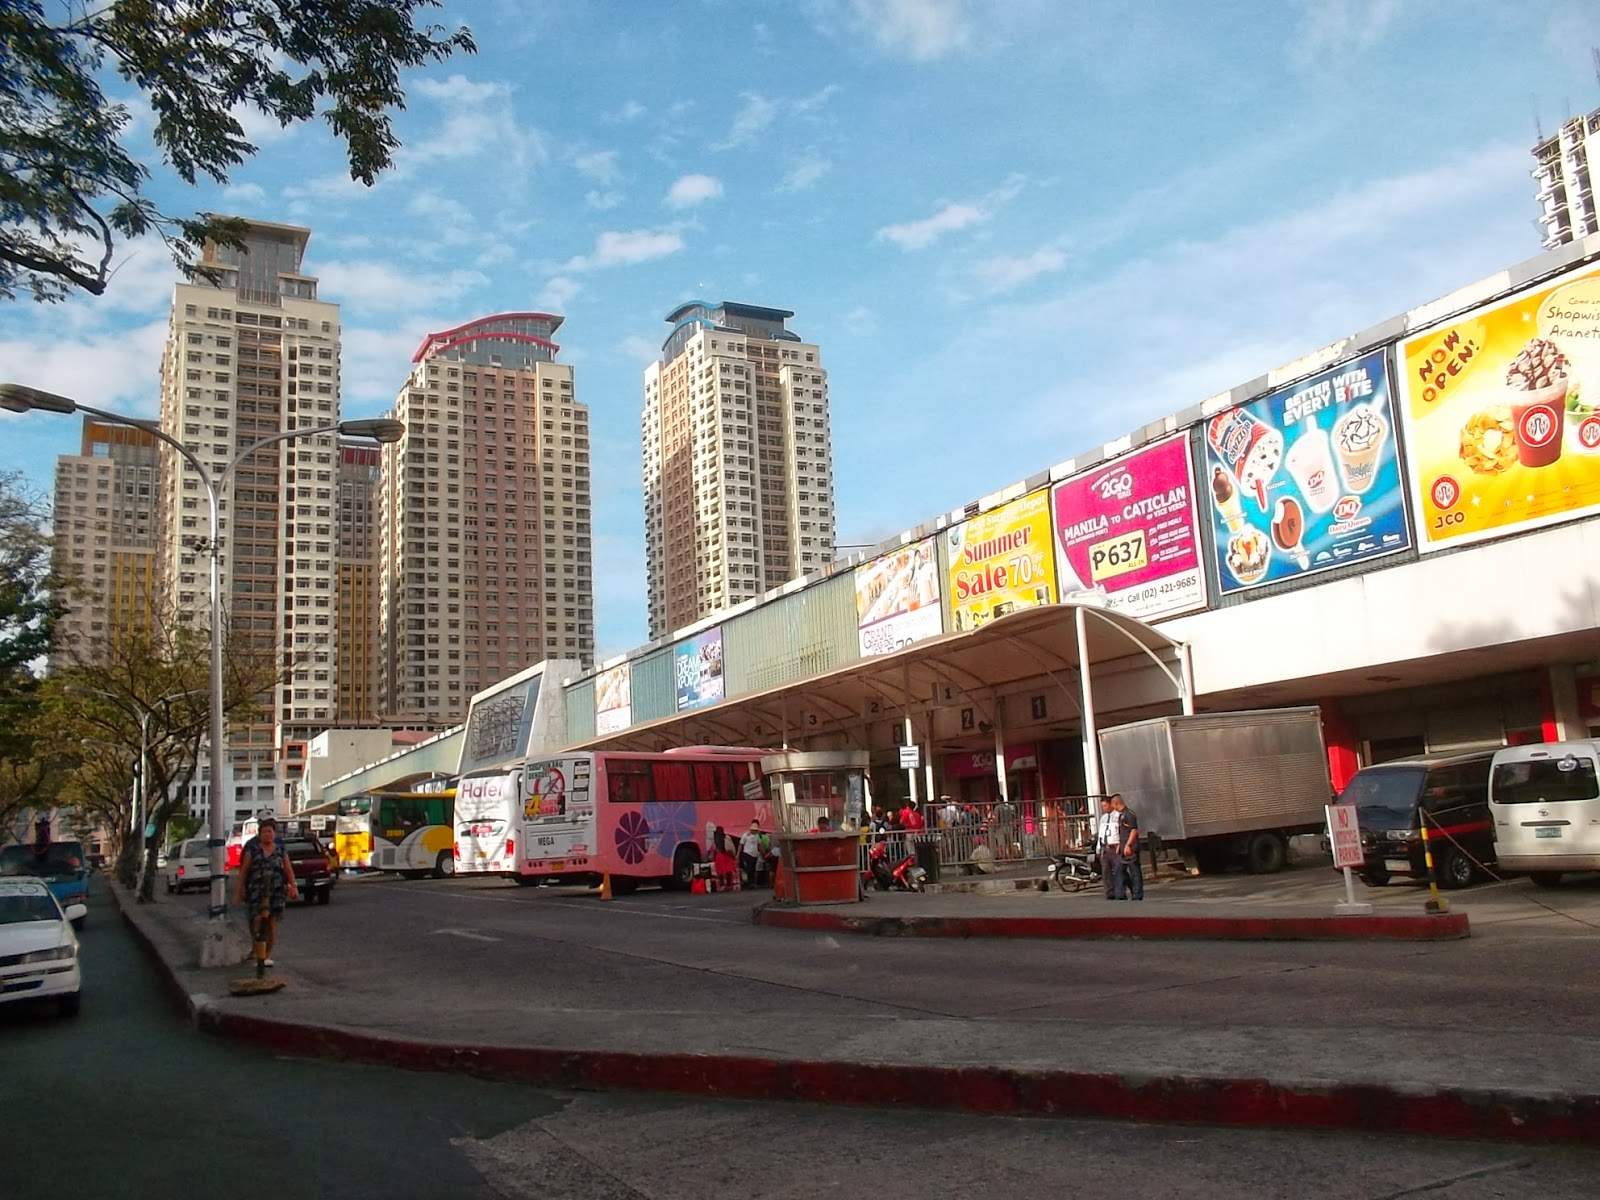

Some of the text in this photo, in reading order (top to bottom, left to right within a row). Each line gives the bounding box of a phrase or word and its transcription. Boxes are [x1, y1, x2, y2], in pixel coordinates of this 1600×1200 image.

[1419, 329, 1460, 383] NOW
[1422, 339, 1480, 403] OPEN!
[1285, 368, 1367, 411] BETTER WITH
[1283, 379, 1373, 427] EVERY BITE
[1101, 473, 1132, 499] 2GO
[1020, 495, 1047, 512] Depot
[1064, 486, 1187, 541] MANILA TO CATICLAN
[1338, 501, 1358, 516] DQ
[1434, 511, 1466, 529] JCO
[964, 526, 1031, 566] Summer
[956, 562, 1008, 600] Sale
[1008, 553, 1033, 588] 70
[1127, 593, 1140, 604] Call
[1142, 587, 1158, 602] (02)
[1159, 575, 1197, 594] 421-9685
[863, 623, 894, 649] GRAND
[870, 701, 879, 713] 2
[1034, 699, 1043, 719] 1
[808, 714, 818, 725] 3
[962, 711, 972, 729] 2
[971, 752, 994, 768] 2GO
[461, 781, 502, 799] Haier
[1338, 808, 1349, 828] NO
[537, 836, 555, 846] MEGA
